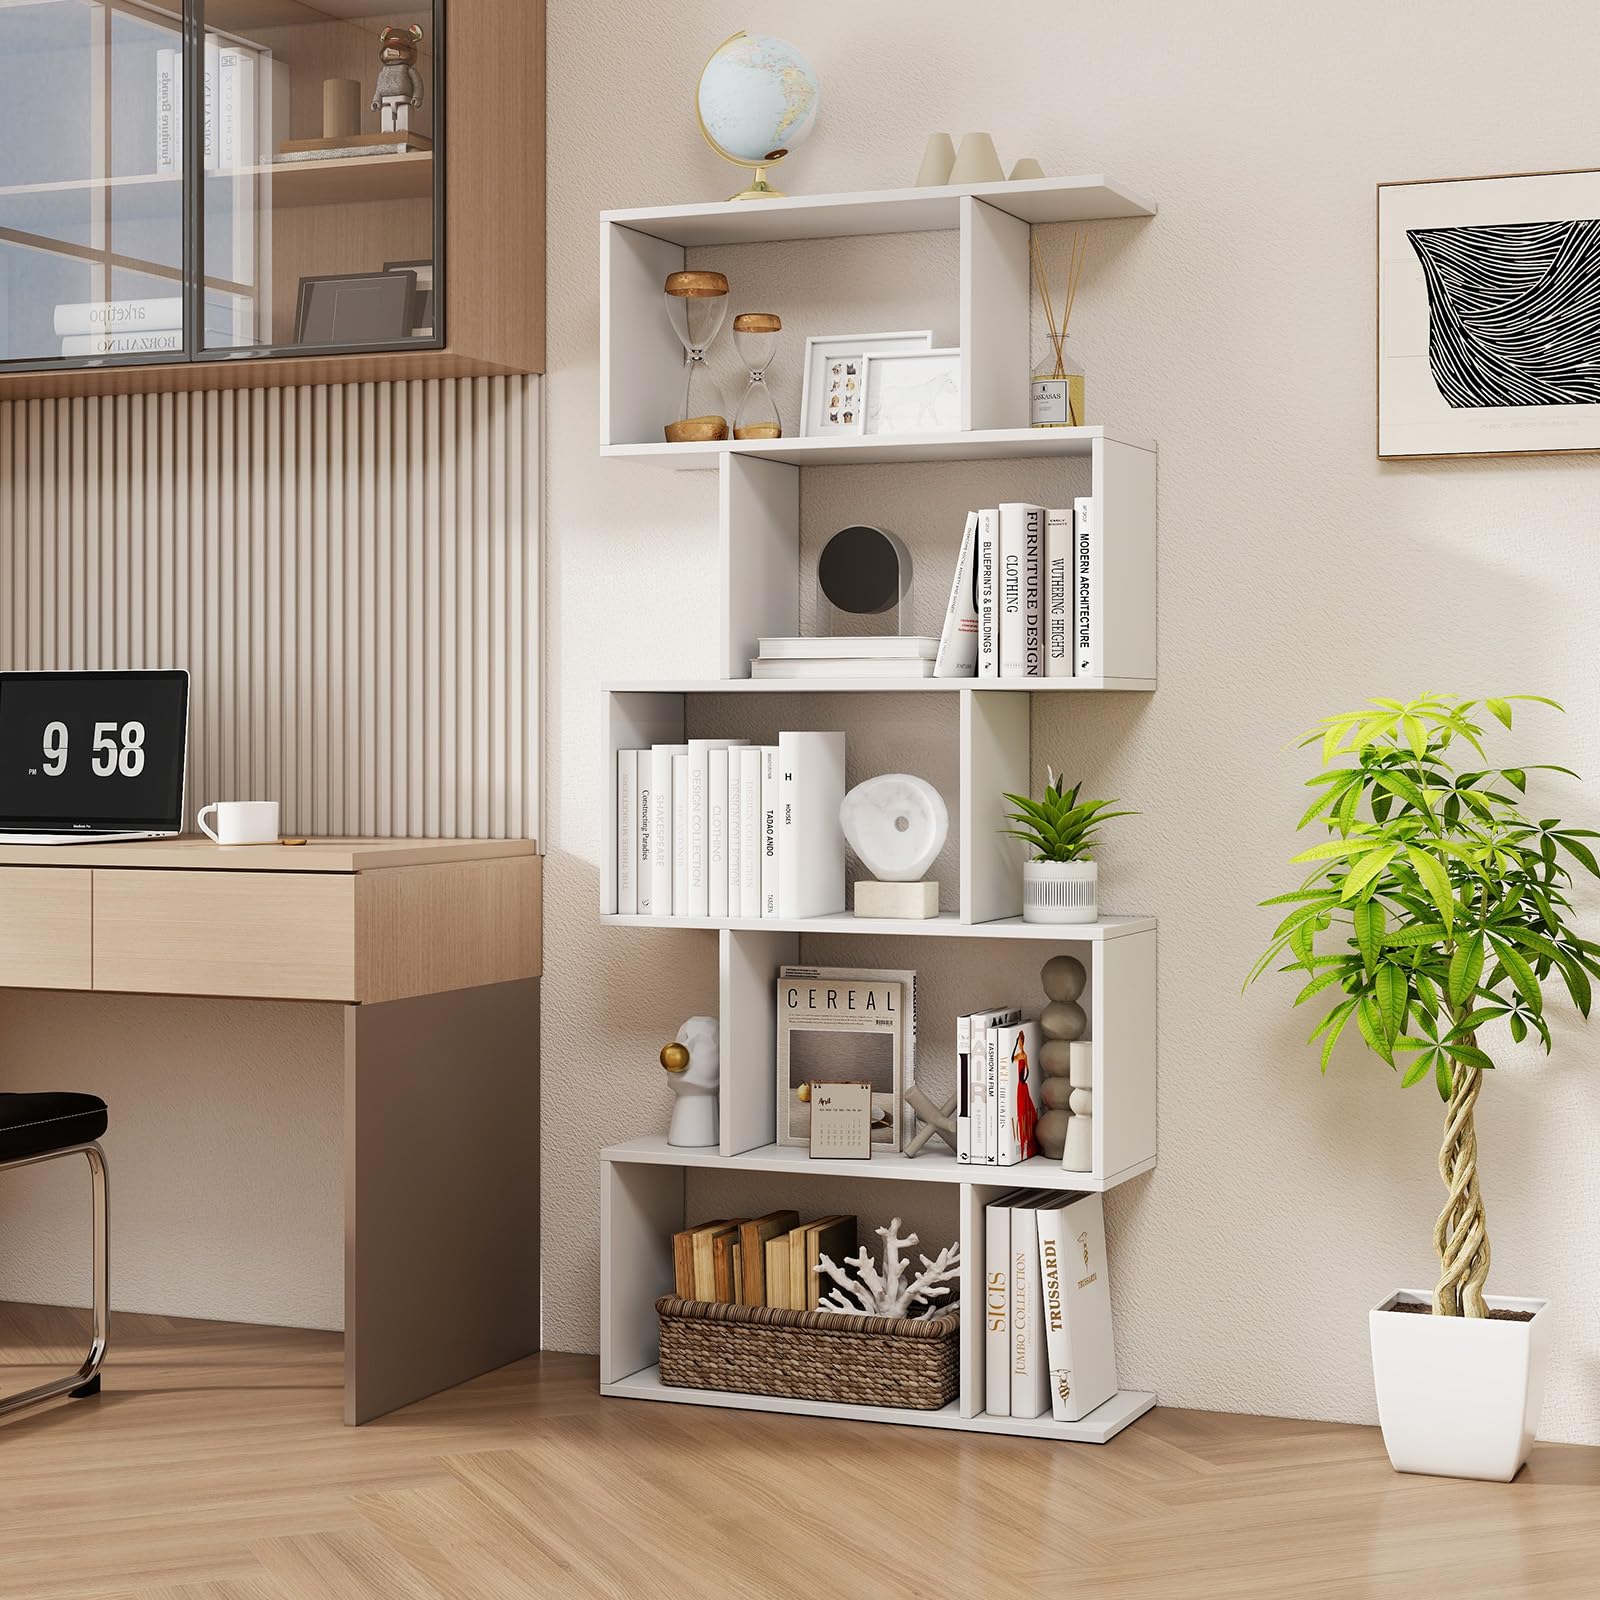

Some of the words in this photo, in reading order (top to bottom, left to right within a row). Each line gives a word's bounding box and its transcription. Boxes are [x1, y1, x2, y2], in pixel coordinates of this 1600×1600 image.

[983, 541, 992, 596] BLUEPRINTS
[1026, 512, 1038, 609] FURNITURE
[1079, 533, 1090, 574] MODERN
[1006, 555, 1019, 613] CLOTHING
[1051, 558, 1065, 615] WUTHERING
[983, 607, 992, 654] BUILDINGS
[1051, 619, 1065, 659] HEIGHTS
[1079, 576, 1090, 648] ARCHITECTURE
[1026, 615, 1038, 676] DESIGN
[28, 768, 37, 776] PM
[42, 721, 69, 777] 9
[91, 721, 146, 777] 58
[784, 772, 792, 781] H
[640, 789, 650, 832] Constructing
[692, 769, 702, 812] DESIGN
[642, 833, 650, 861] Paradies
[656, 794, 665, 867] SHAKESPEARE
[712, 806, 721, 862] CLOTHING
[766, 809, 774, 835] TADAO
[766, 835, 774, 857] ANDO
[692, 815, 702, 888] COLLECTION
[787, 988, 896, 1012] CEREAL
[988, 1072, 995, 1081] IN
[987, 1272, 1007, 1332] SICIS
[1043, 1239, 1063, 1333] TRUSSARDI
